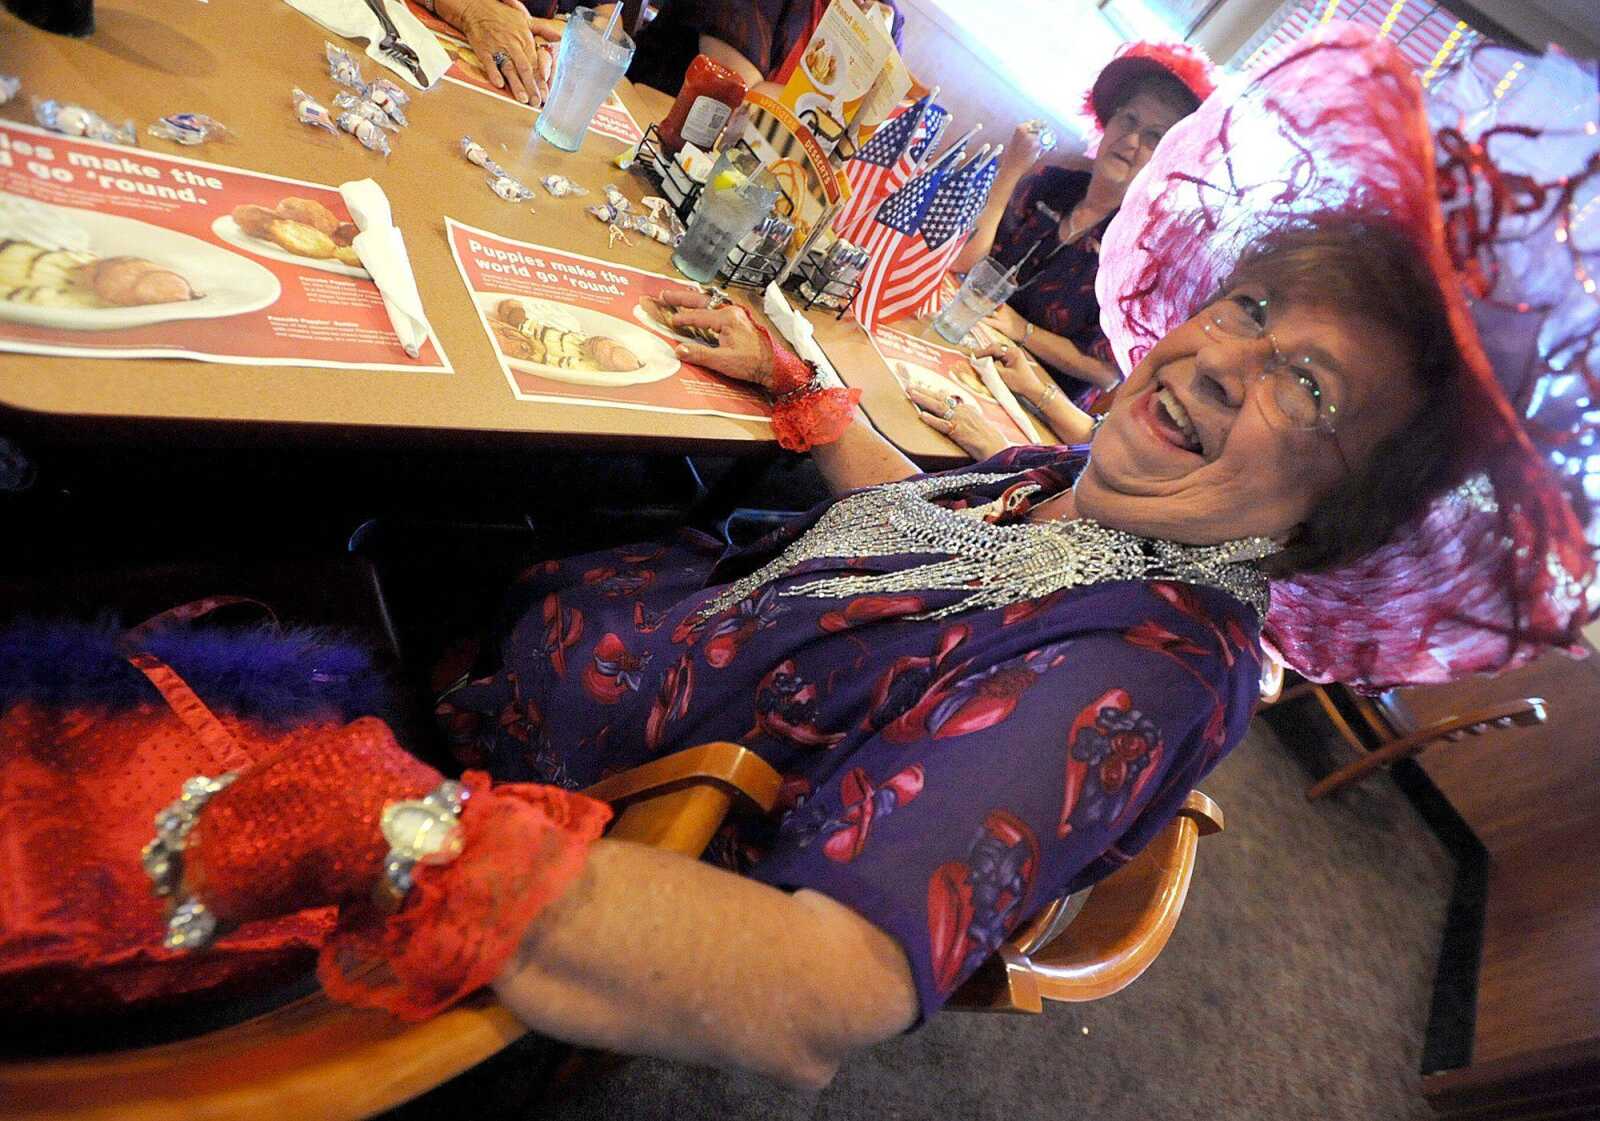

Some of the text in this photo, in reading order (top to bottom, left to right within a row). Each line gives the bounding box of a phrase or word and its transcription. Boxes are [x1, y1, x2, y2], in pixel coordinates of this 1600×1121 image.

[26, 160, 74, 183] go
[67, 151, 160, 179] make
[169, 168, 223, 190] the
[468, 239, 629, 286] Puppies make the
[474, 258, 531, 278] world
[535, 270, 559, 284] go
